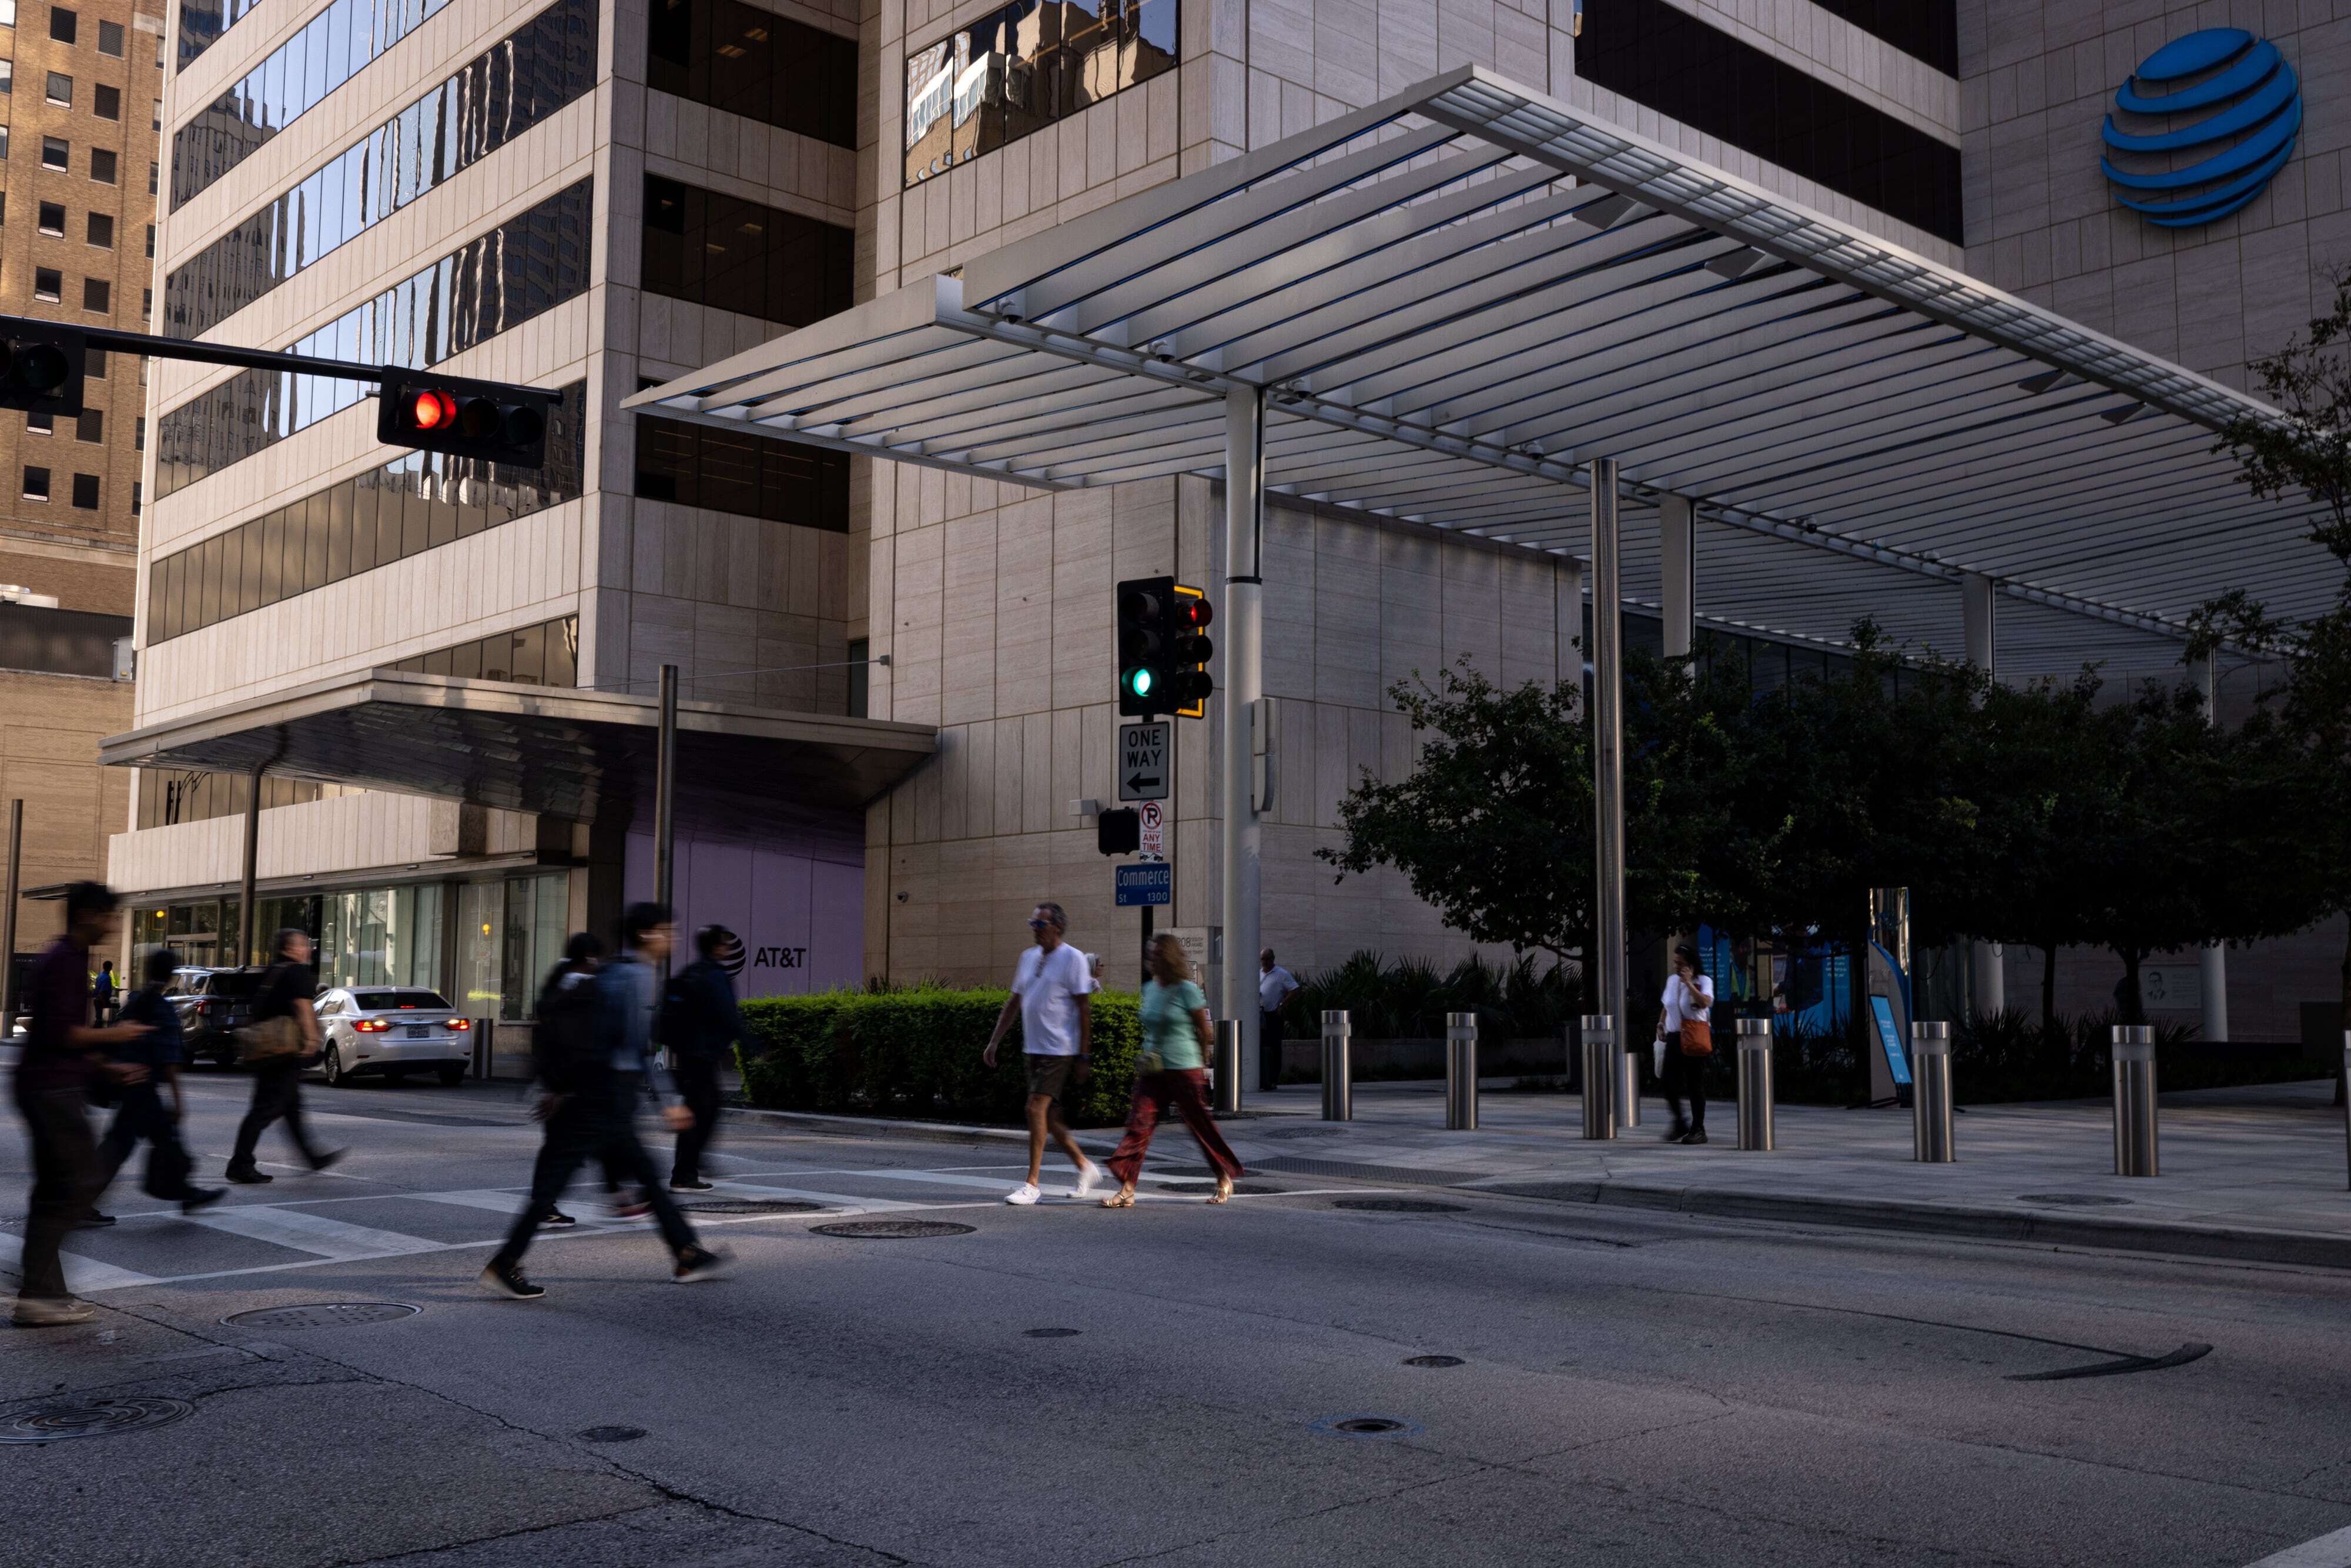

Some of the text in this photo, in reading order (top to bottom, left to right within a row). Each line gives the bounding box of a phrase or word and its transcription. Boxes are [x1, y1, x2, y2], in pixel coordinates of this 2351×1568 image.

[1128, 729, 1160, 747] ONE
[1127, 749, 1161, 768] WAY
[1143, 833, 1160, 842] ANY
[1143, 842, 1161, 852] TIME
[1118, 870, 1169, 887] Commerce
[1118, 892, 1167, 903] St 1300
[754, 947, 806, 968] AT&T
